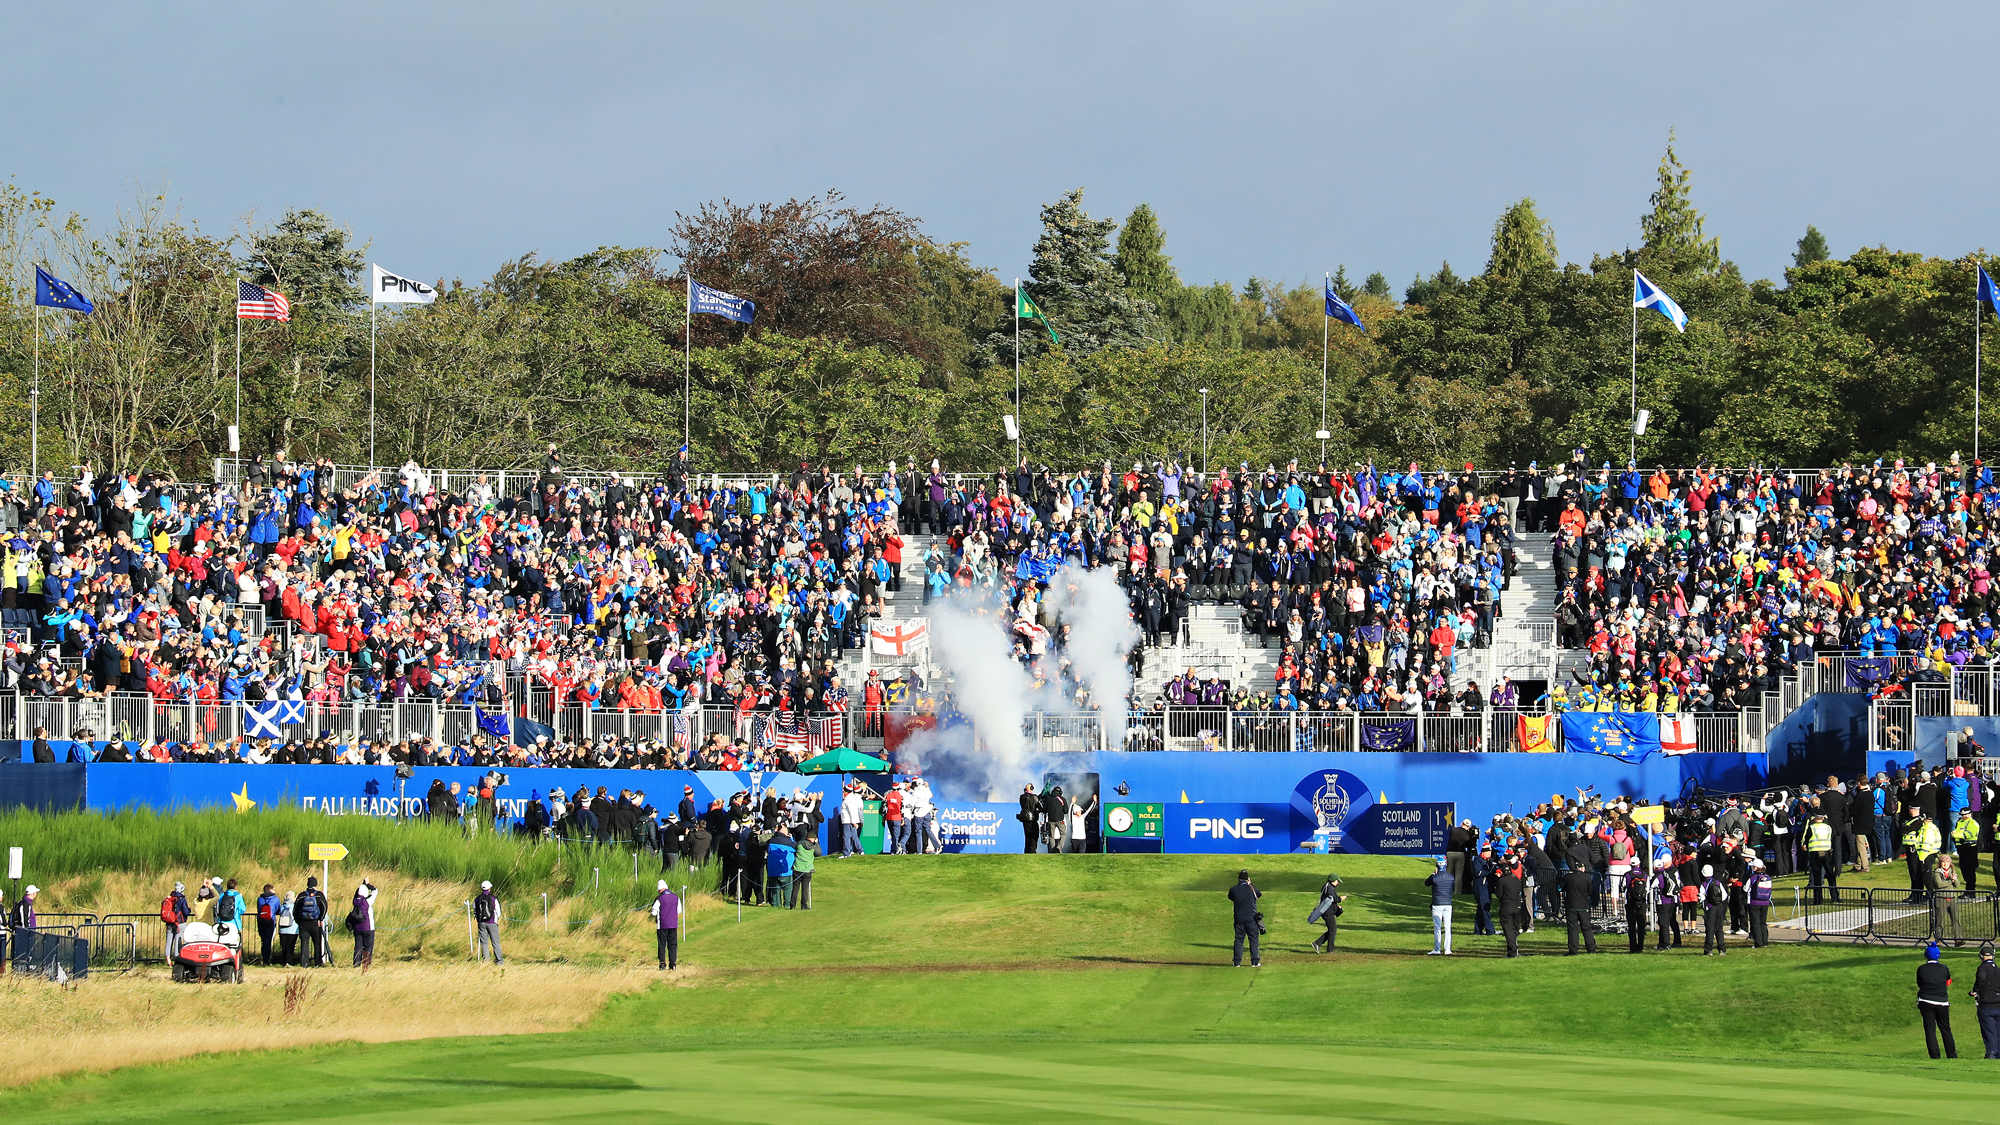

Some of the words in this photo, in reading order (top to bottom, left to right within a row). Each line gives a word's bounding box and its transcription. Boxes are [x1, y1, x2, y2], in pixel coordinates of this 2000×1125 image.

[303, 796, 316, 813] IT
[320, 797, 348, 816] ALL
[352, 797, 398, 816] LEADS
[941, 807, 996, 821] Aberdeen
[1382, 810, 1421, 823] SCOTLAND
[1435, 810, 1440, 826] 1
[941, 822, 996, 836] Standard
[1190, 818, 1264, 839] PING
[1384, 826, 1404, 837] Proudly
[1404, 827, 1418, 836] Hosts
[941, 838, 996, 846] Investments
[1379, 839, 1423, 849] #SolheimCup2019
